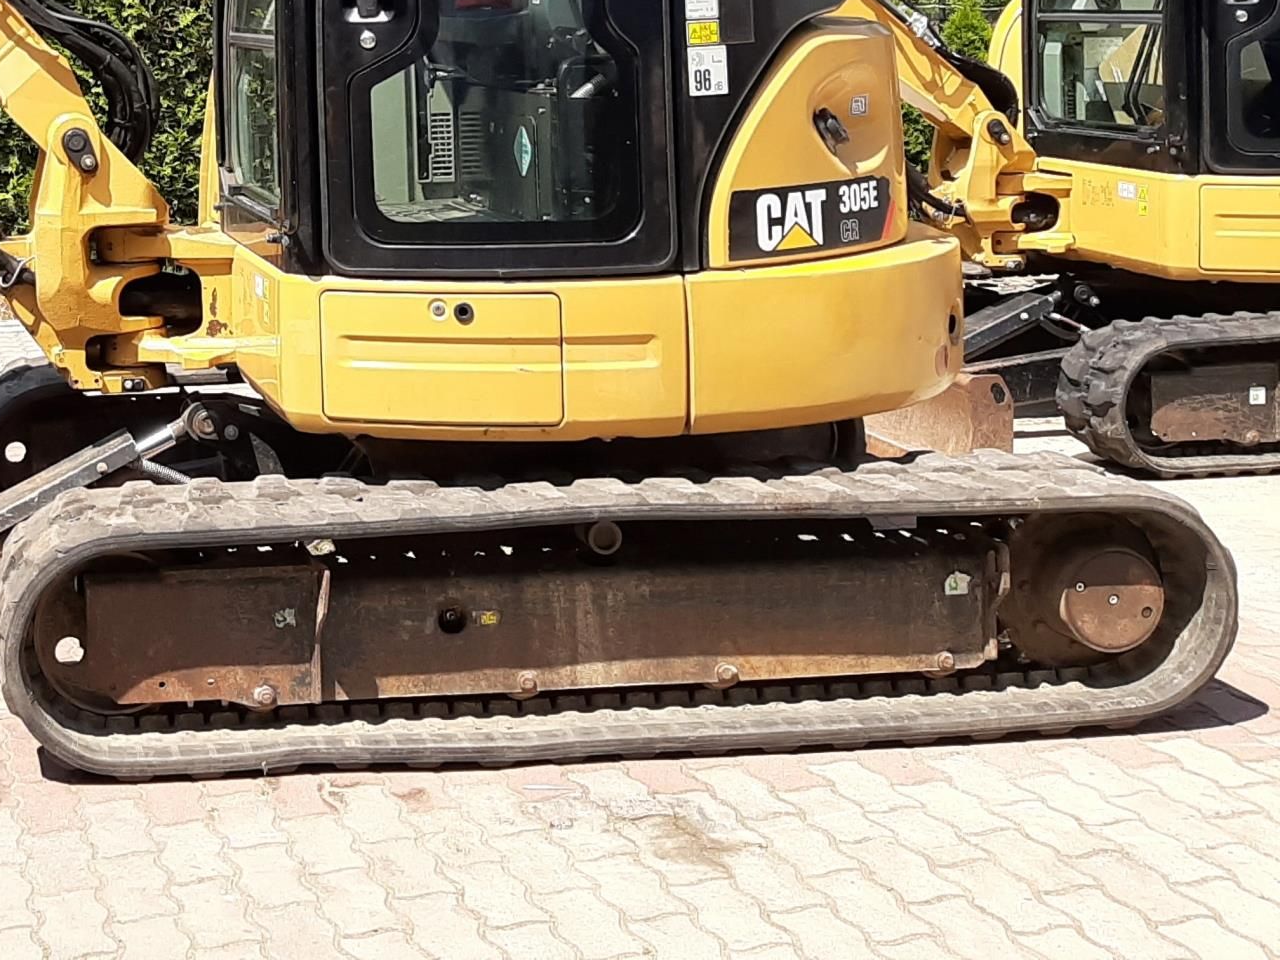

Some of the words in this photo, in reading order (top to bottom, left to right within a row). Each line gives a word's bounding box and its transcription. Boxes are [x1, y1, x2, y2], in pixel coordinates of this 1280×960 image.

[694, 69, 712, 91] 96
[756, 189, 826, 252] CAT
[838, 180, 879, 214] 305E
[840, 219, 860, 242] CR
